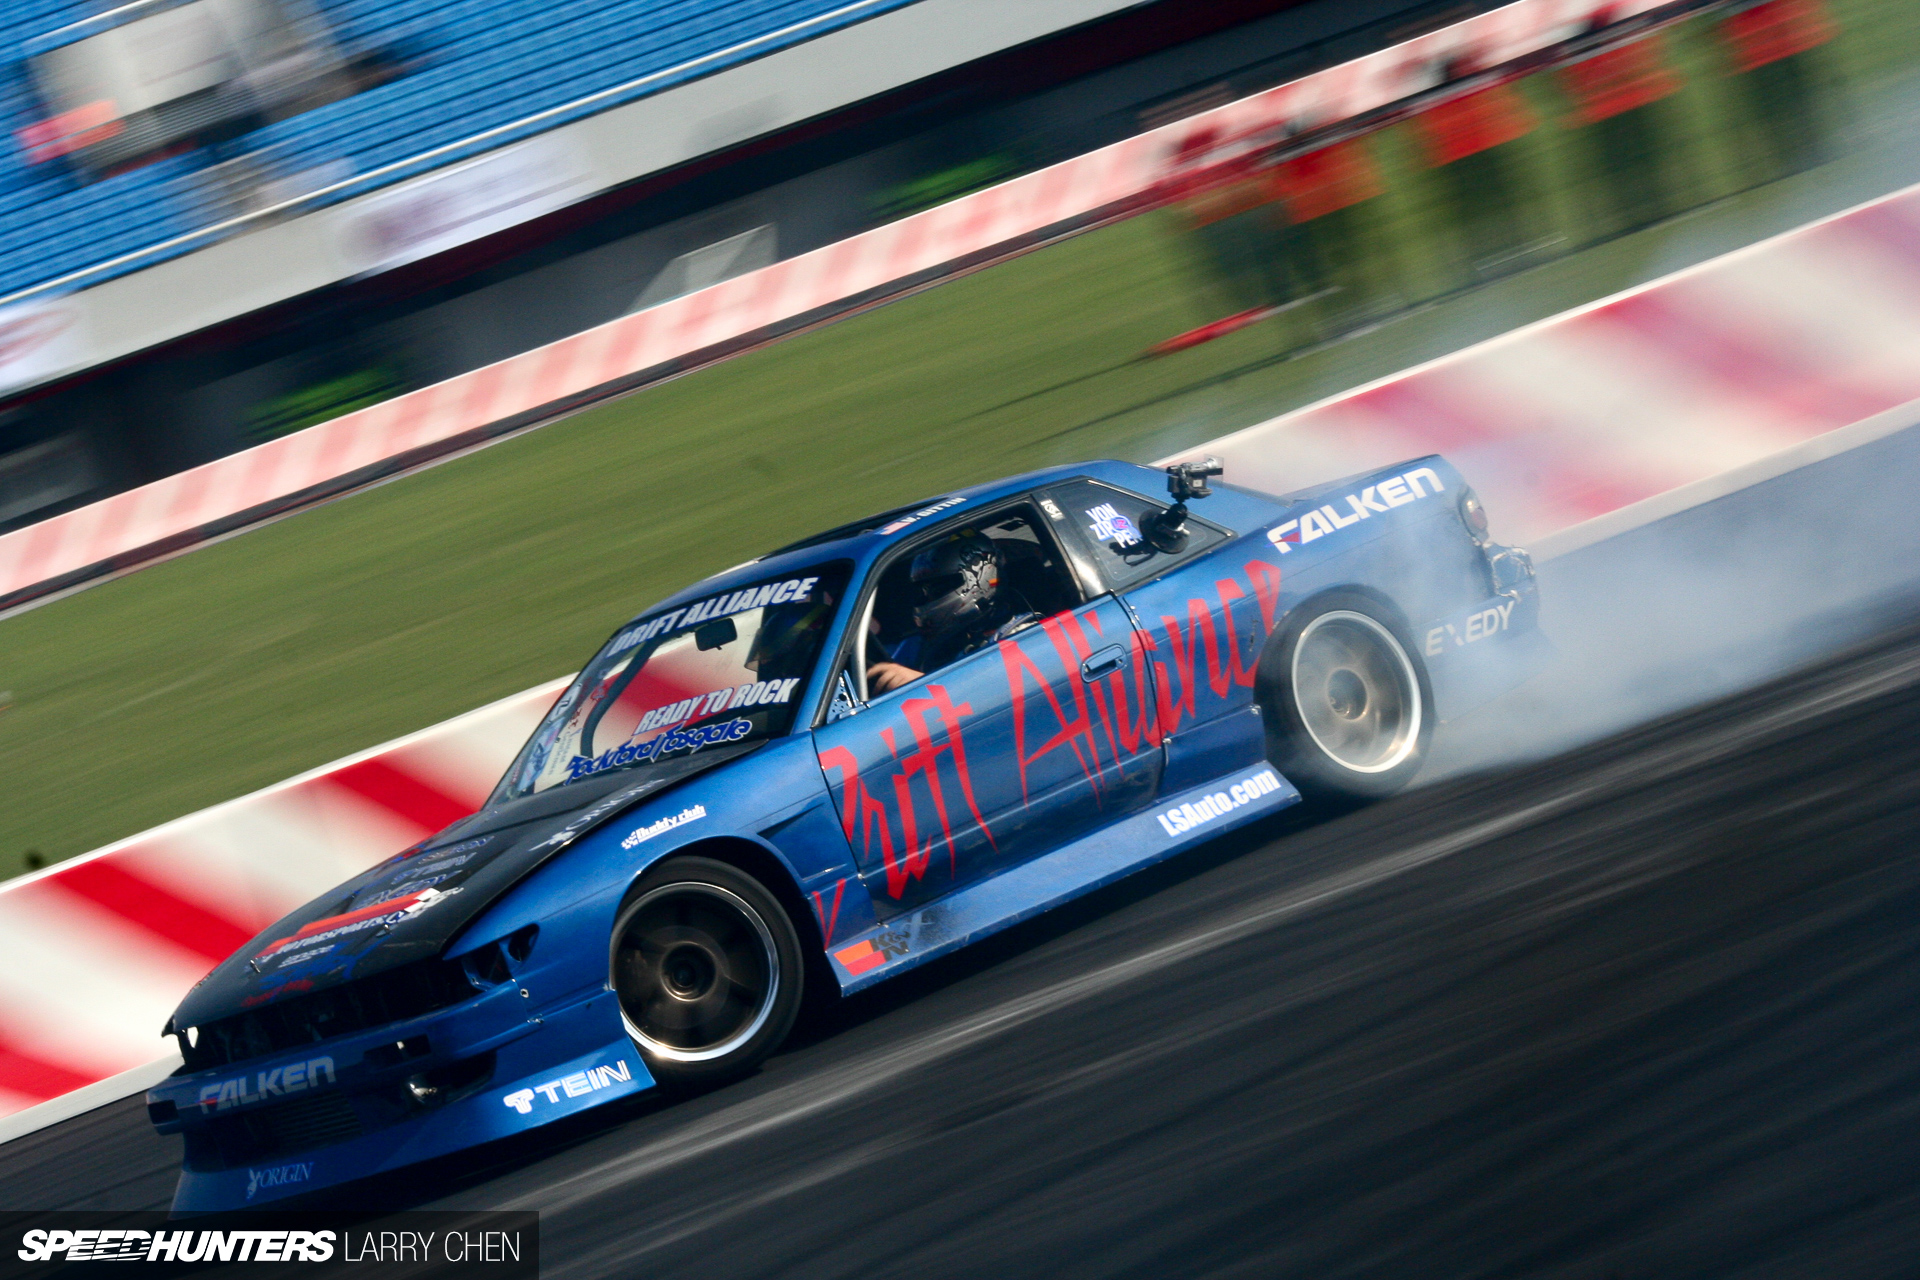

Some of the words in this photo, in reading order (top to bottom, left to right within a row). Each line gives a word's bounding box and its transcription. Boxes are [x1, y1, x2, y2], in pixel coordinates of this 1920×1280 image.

[1085, 503, 1118, 523] VON
[1266, 467, 1445, 554] FALKEN
[606, 608, 686, 658] DRIFT
[676, 577, 820, 630] ALLIANCE
[631, 694, 706, 737] READY
[699, 687, 735, 717] TO
[727, 678, 800, 710] ROCK
[1156, 770, 1282, 838] LSAuto.com
[200, 1055, 337, 1115] FALKEN
[259, 1161, 315, 1188] ORIGIN
